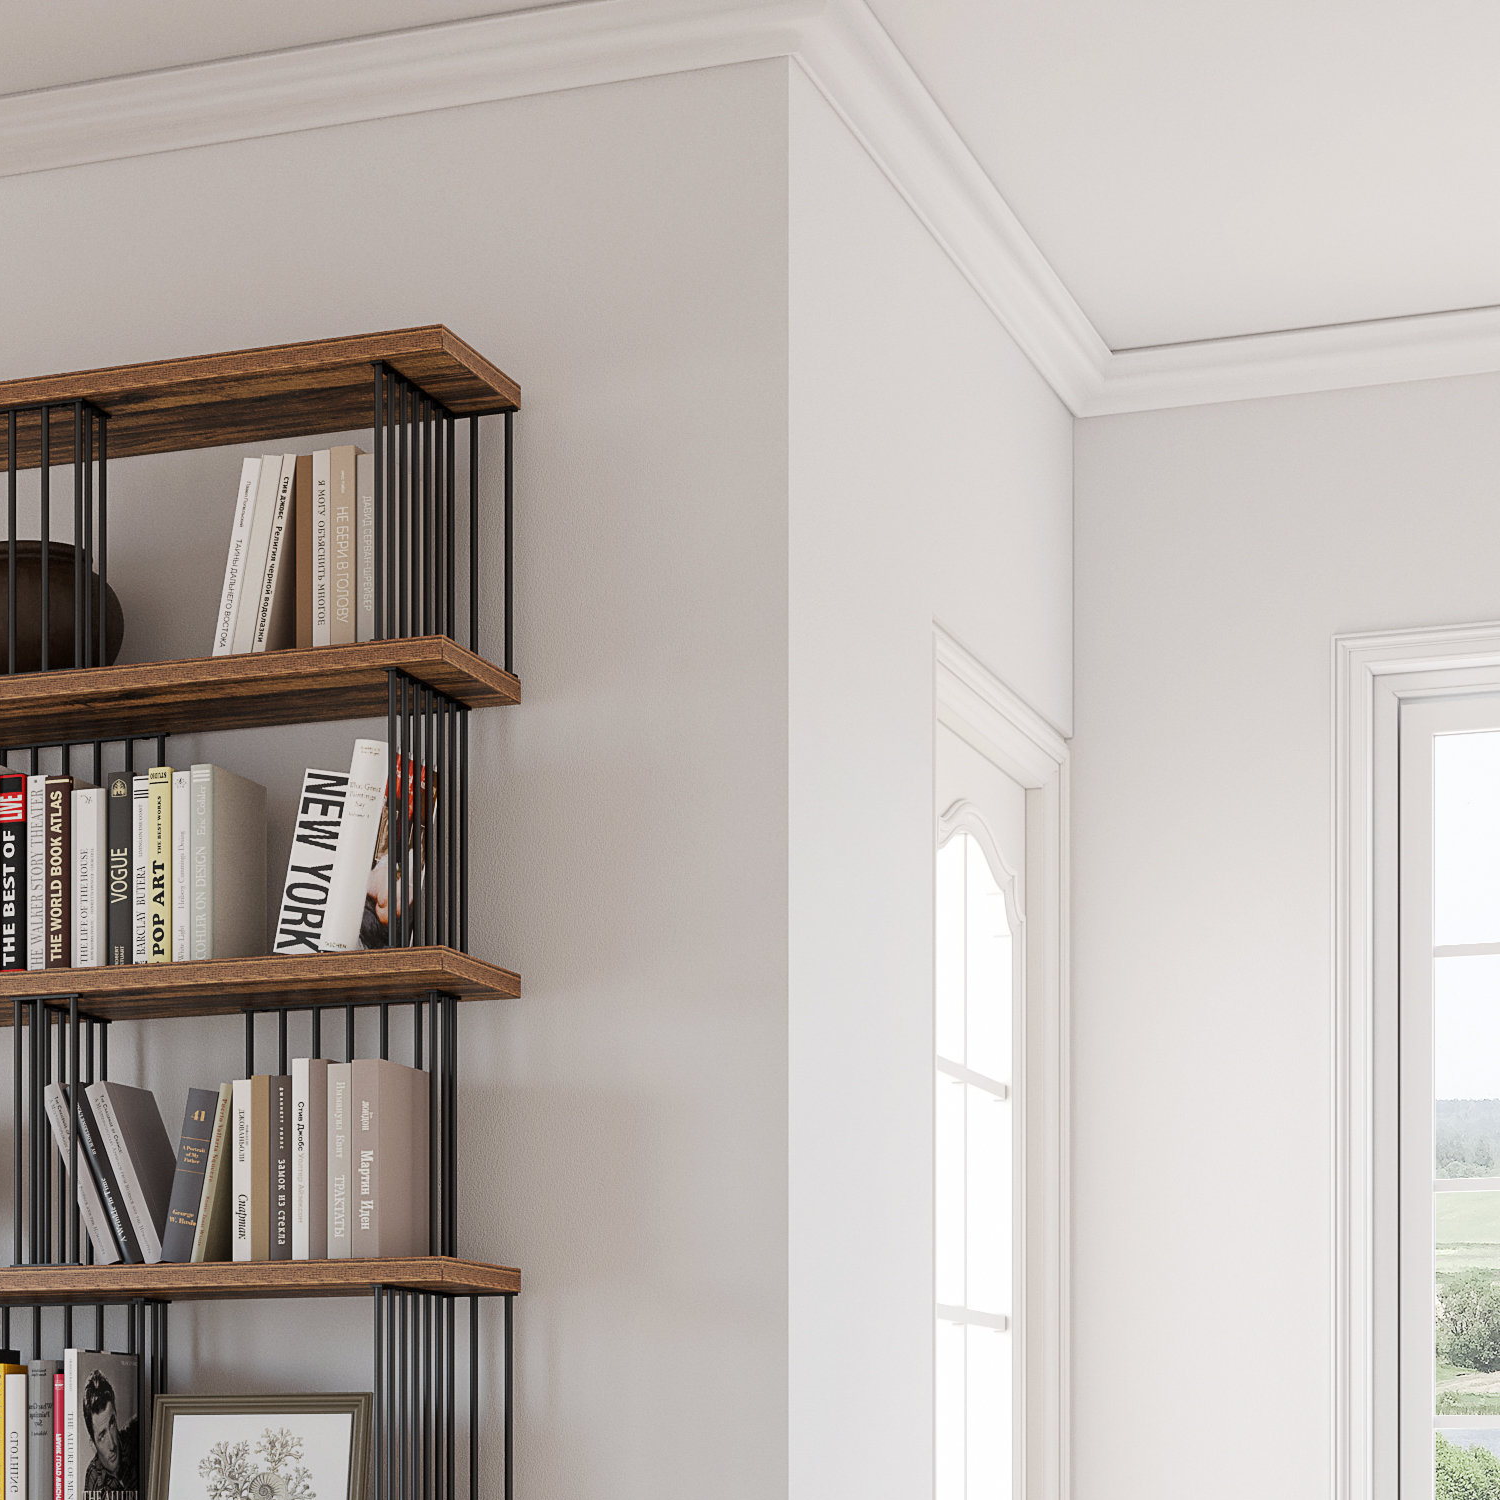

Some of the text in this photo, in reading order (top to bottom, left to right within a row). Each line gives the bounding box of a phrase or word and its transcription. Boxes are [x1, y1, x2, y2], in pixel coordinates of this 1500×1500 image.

[317, 489, 326, 517] МОГУ
[337, 506, 348, 522] НЕ
[271, 526, 283, 561] Религия
[317, 520, 326, 581] ОБЪЯСНИТЬ
[337, 526, 348, 557] БЕРИ
[337, 562, 348, 570] В
[257, 595, 270, 643] водолазки
[317, 584, 326, 626] МНОГОЕ
[337, 574, 348, 623] ГОЛОВУ
[220, 611, 232, 648] ВОСТОКА
[30, 789, 44, 847] THEATER
[0, 794, 23, 966] THE BEST OF LIVE
[31, 852, 44, 890] STORY
[50, 790, 63, 961] THE WORLD BOOK ATLAS
[80, 848, 88, 881] HOUSE
[111, 847, 127, 904] VOGUE
[136, 865, 146, 905] BUTERA
[152, 859, 165, 907] ART
[196, 845, 206, 887] DESIGN
[276, 772, 350, 954] NEW YORK
[31, 894, 44, 944] WALKER
[196, 891, 206, 909] ON
[80, 942, 88, 964] THE
[136, 911, 146, 955] BARCLAY
[152, 913, 165, 957] POP
[297, 1101, 305, 1151] Стив Джобс
[334, 1174, 345, 1238] ТРАКТАТЫ
[358, 1149, 374, 1230] Мартин Иден
[236, 1193, 249, 1240] Спартак
